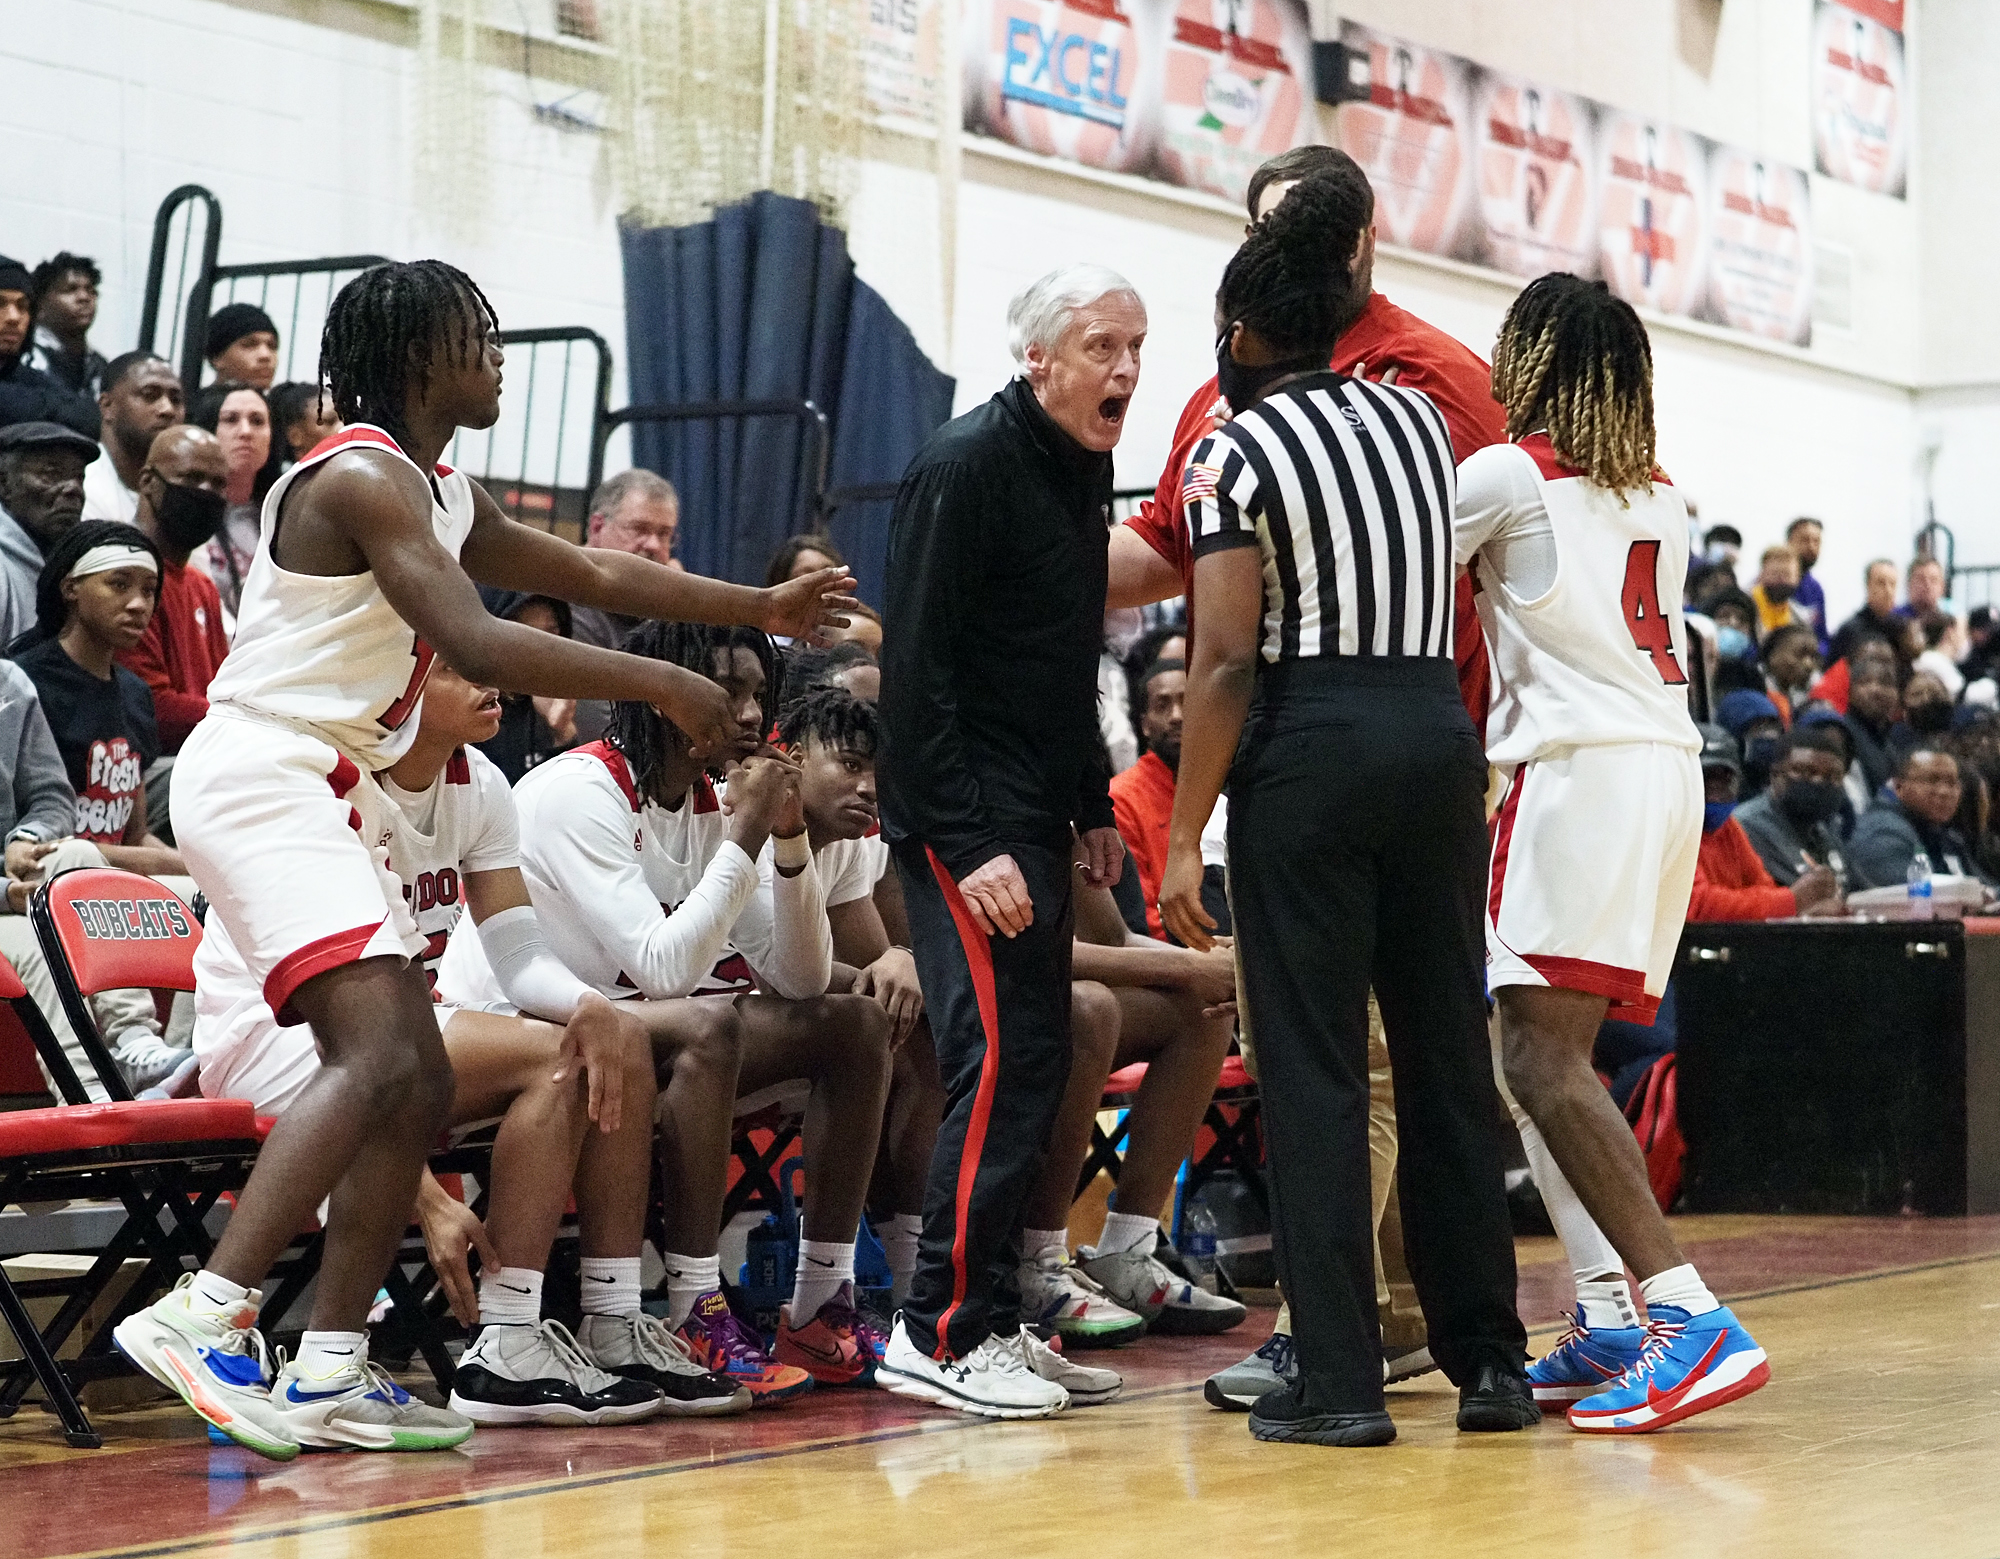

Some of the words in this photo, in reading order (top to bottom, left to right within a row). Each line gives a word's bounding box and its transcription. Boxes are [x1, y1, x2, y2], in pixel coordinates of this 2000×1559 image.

[1003, 17, 1127, 110] EXCEL
[1621, 540, 1689, 685] 4
[69, 900, 190, 939] BOBCATS
